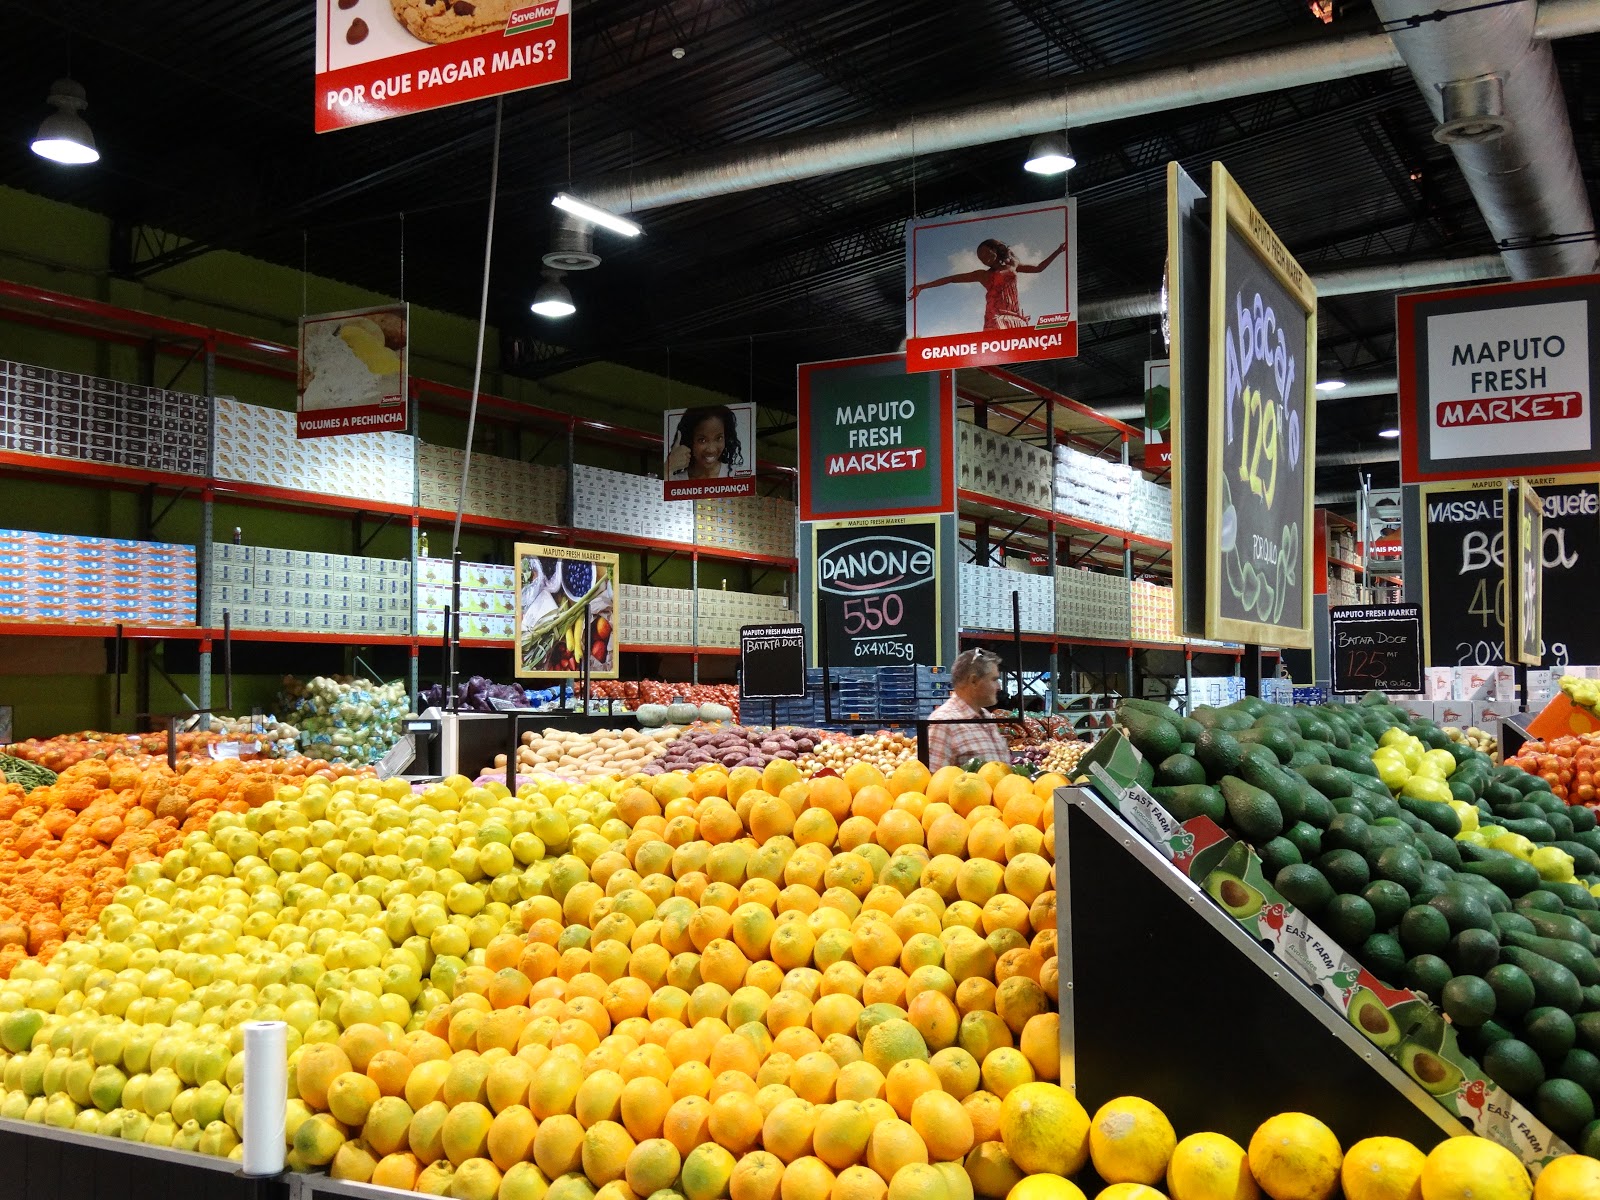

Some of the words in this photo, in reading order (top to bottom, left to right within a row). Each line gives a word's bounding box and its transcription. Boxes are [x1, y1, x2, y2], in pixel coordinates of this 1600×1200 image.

[511, 6, 555, 25] SaveMor
[327, 85, 365, 110] POR
[371, 74, 411, 100] QUE
[418, 57, 485, 90] PAGAR
[491, 39, 556, 74] MAIS?
[1039, 315, 1068, 325] SaveMor
[921, 343, 977, 360] GRANDE
[981, 333, 1062, 353] POUPANÇA!
[1452, 335, 1565, 366] MAPUTO
[1471, 366, 1546, 394] FRESH
[300, 418, 341, 430] VOLUMES
[342, 419, 350, 427] A
[351, 412, 403, 427] PECHINCHA
[835, 399, 915, 426] MAPUTO
[1442, 394, 1576, 426] MARKET
[849, 425, 902, 449] FRESH
[1239, 385, 1277, 510] 129
[828, 449, 923, 475] MARKET
[670, 486, 702, 496] GRANDE
[704, 483, 749, 494] POUPANÇA!
[1471, 480, 1502, 488] MAPUTO
[1527, 477, 1556, 485] MARKET
[1428, 500, 1490, 523] MASSA
[542, 547, 565, 557] MAPUTO
[566, 549, 580, 559] FRESH
[581, 551, 601, 561] MARKET
[843, 593, 904, 635] 550
[1333, 610, 1364, 618] MAPUTO
[1365, 609, 1387, 617] FRESH
[1388, 608, 1418, 616] MARKET
[746, 638, 781, 653] BATATA
[782, 638, 802, 648] DOCE
[1337, 631, 1375, 648] BATATA
[1376, 631, 1408, 644] DOCE
[1347, 649, 1387, 678] 125
[1128, 791, 1154, 808] EAST
[1151, 807, 1171, 833] FARM
[1285, 924, 1314, 943] EAST
[1312, 941, 1335, 970] FARM
[1487, 1103, 1519, 1123] EAST
[1517, 1122, 1543, 1153] FARM
